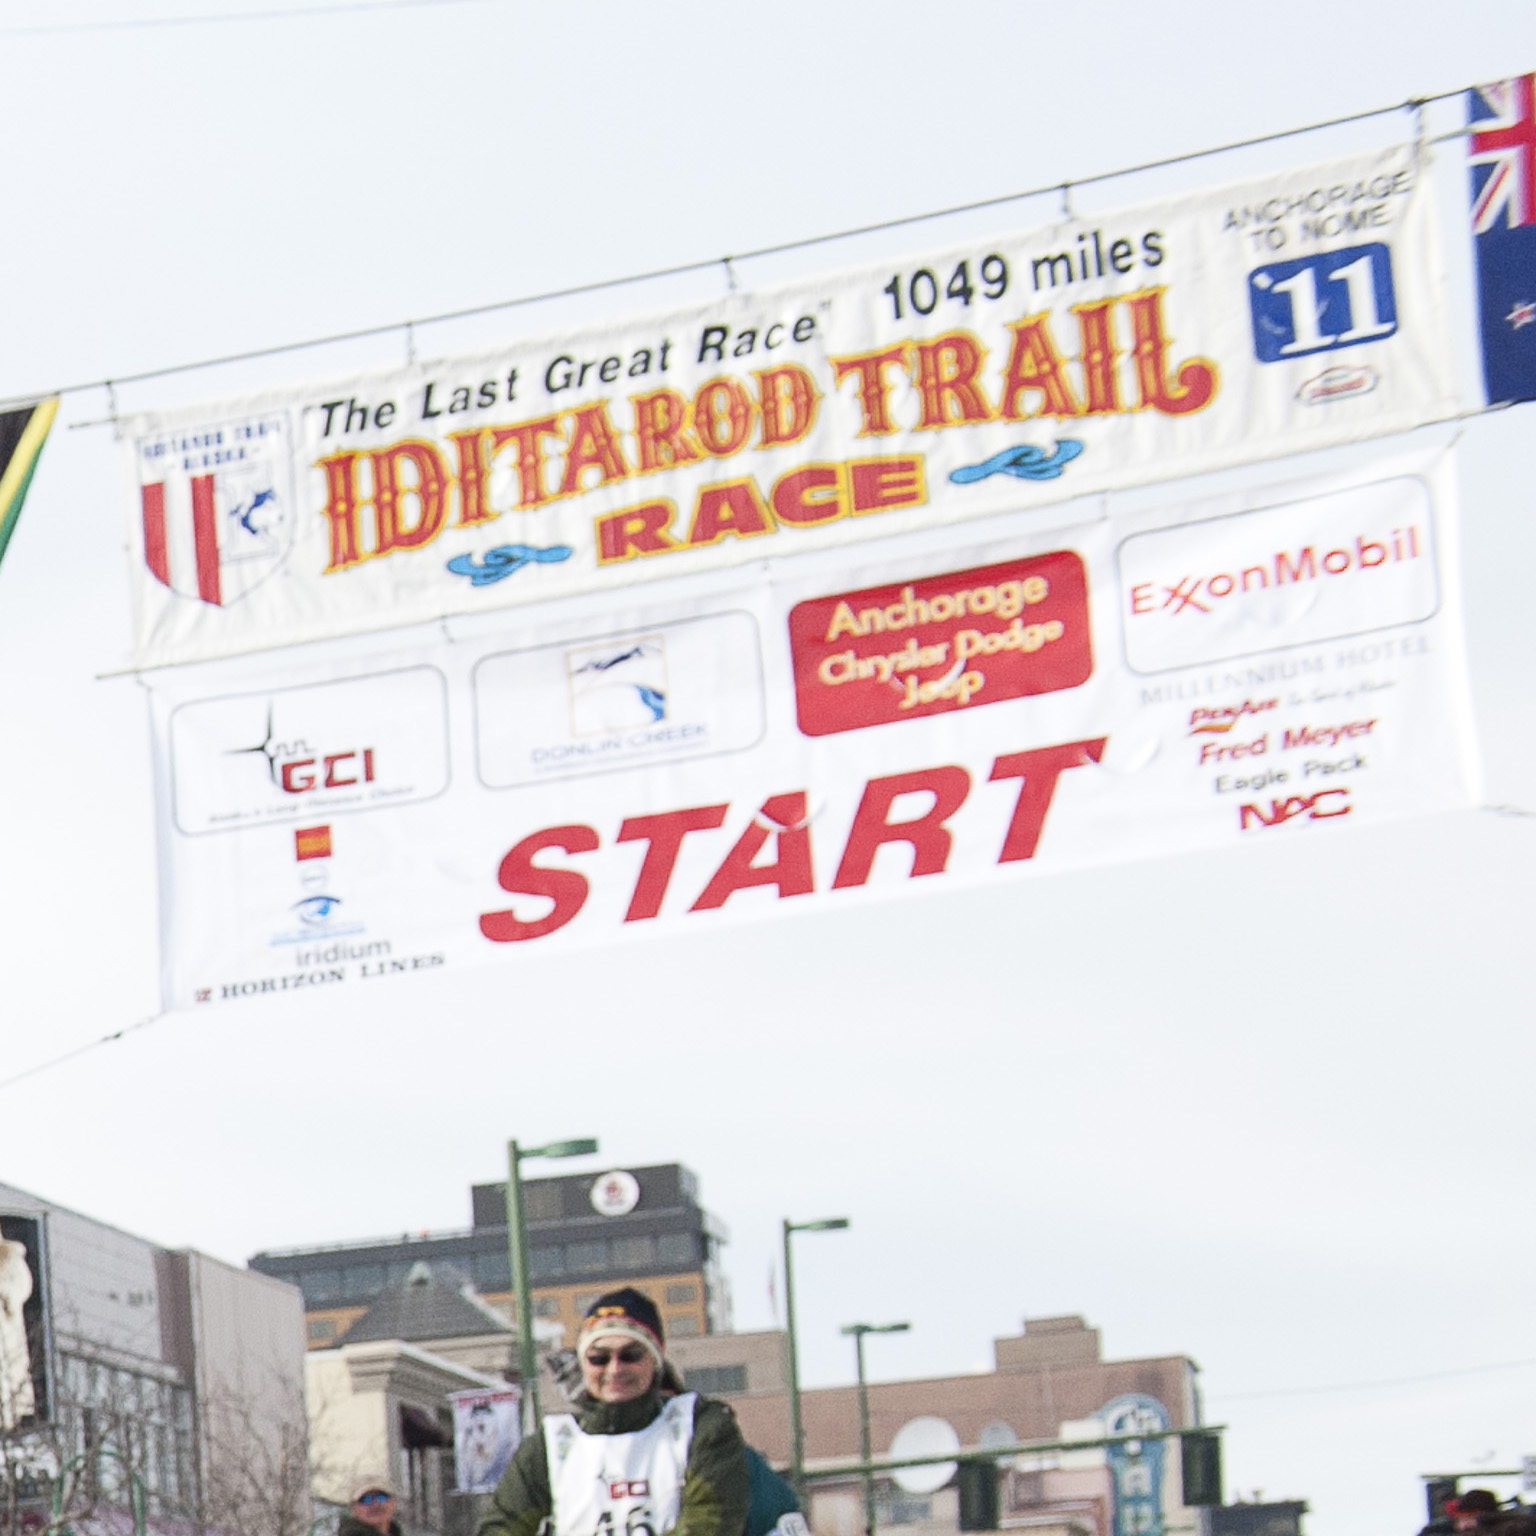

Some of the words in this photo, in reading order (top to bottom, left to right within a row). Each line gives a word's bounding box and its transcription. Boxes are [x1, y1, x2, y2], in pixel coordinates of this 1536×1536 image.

[1249, 227, 1287, 253] TO
[1302, 201, 1393, 243] NOME
[882, 254, 1009, 319] 1049
[1032, 229, 1164, 292] miles
[421, 367, 519, 421] Last
[543, 338, 673, 394] Great
[315, 362, 824, 575] IDITAROD
[828, 284, 1219, 438] TRAIL
[595, 453, 928, 565] RACE
[1130, 524, 1418, 615] ExxonMobil
[825, 573, 1048, 642] Anchorage
[819, 639, 949, 686] Chrysler
[955, 620, 1065, 660] Dodge
[1141, 653, 1325, 706] MILLENNIUM
[1335, 633, 1430, 670] HOTEL
[281, 748, 376, 794] GCI
[1198, 733, 1268, 766] Fred
[1282, 718, 1378, 752] Meyer
[1215, 768, 1288, 794] Eagle
[1303, 753, 1367, 777] Pack
[478, 736, 1110, 943] START
[220, 966, 345, 1000] HORIZON
[359, 952, 446, 980] LINES
[295, 938, 393, 967] iridium
